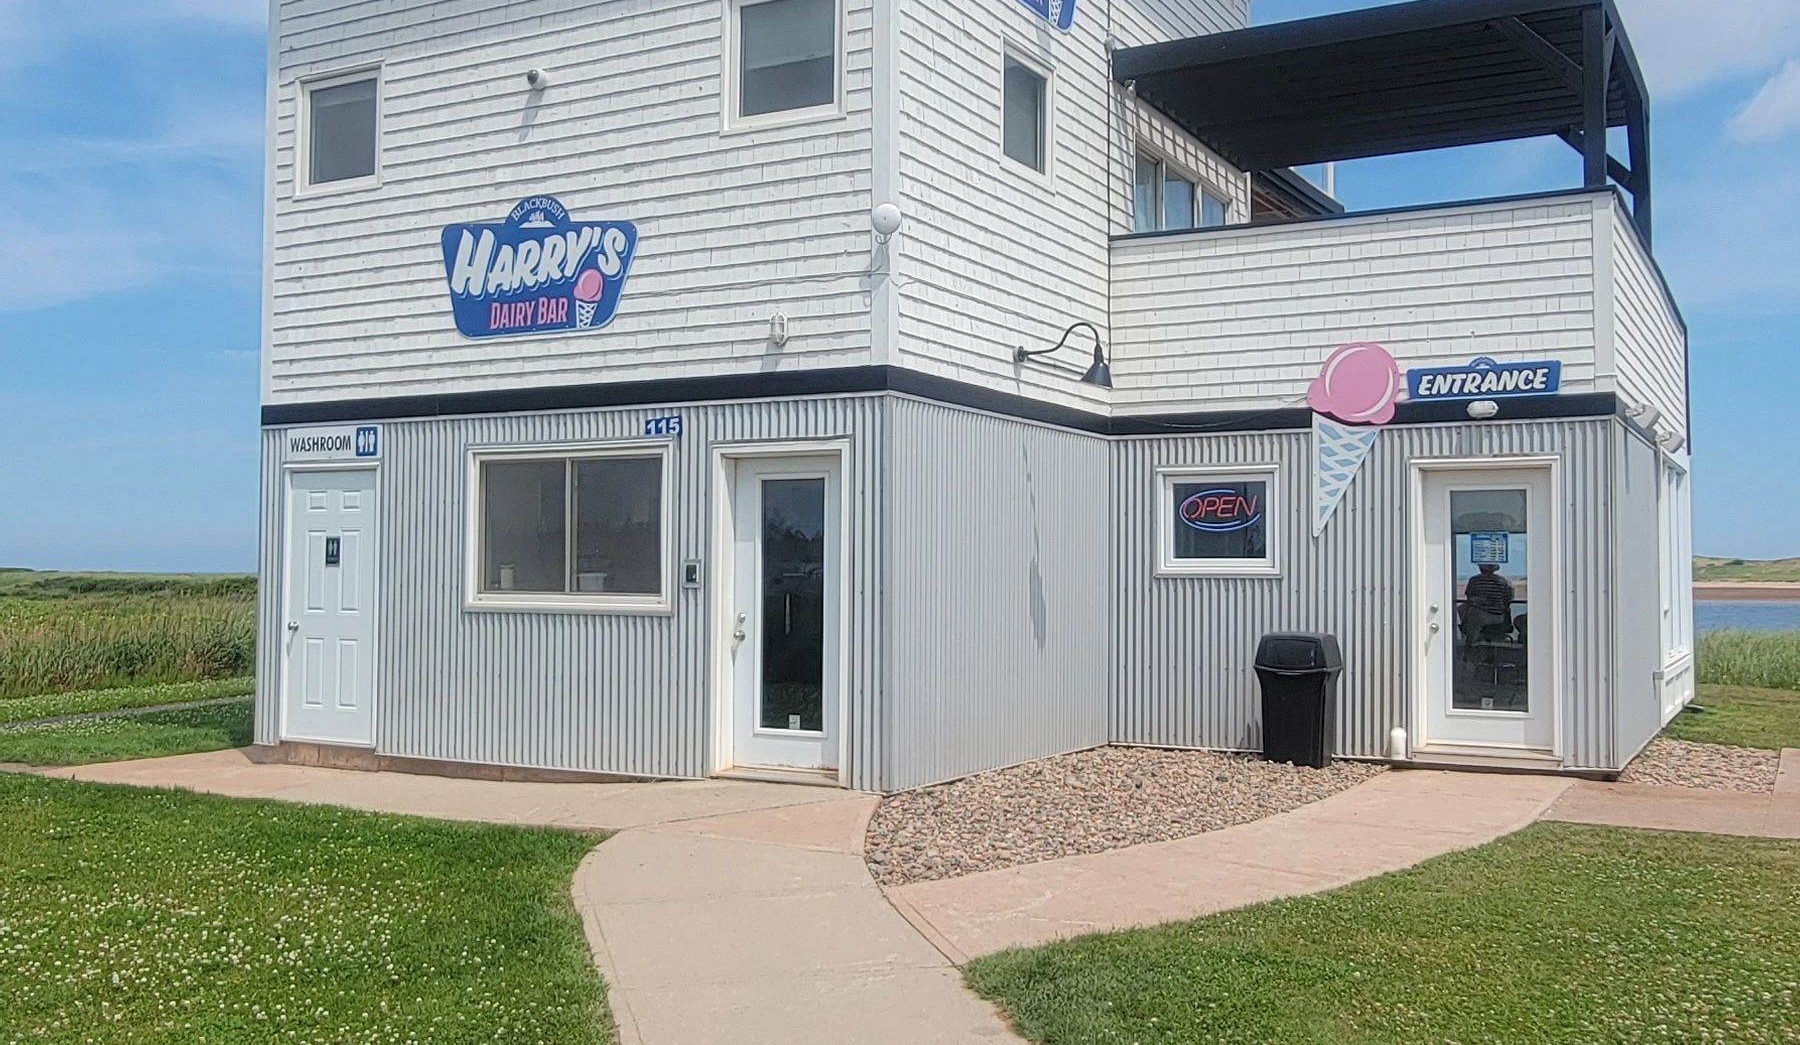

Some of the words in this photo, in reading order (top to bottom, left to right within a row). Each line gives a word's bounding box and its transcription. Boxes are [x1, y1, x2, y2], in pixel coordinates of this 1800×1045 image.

[511, 198, 565, 222] BLACKBUSH
[451, 226, 628, 298] HARRY'S
[490, 300, 537, 330] DAIRY
[537, 297, 569, 325] BAR
[1417, 368, 1549, 396] ENTRANCE
[646, 417, 680, 435] 115
[290, 435, 352, 453] WASHROOM
[1182, 494, 1258, 519] OPEN
